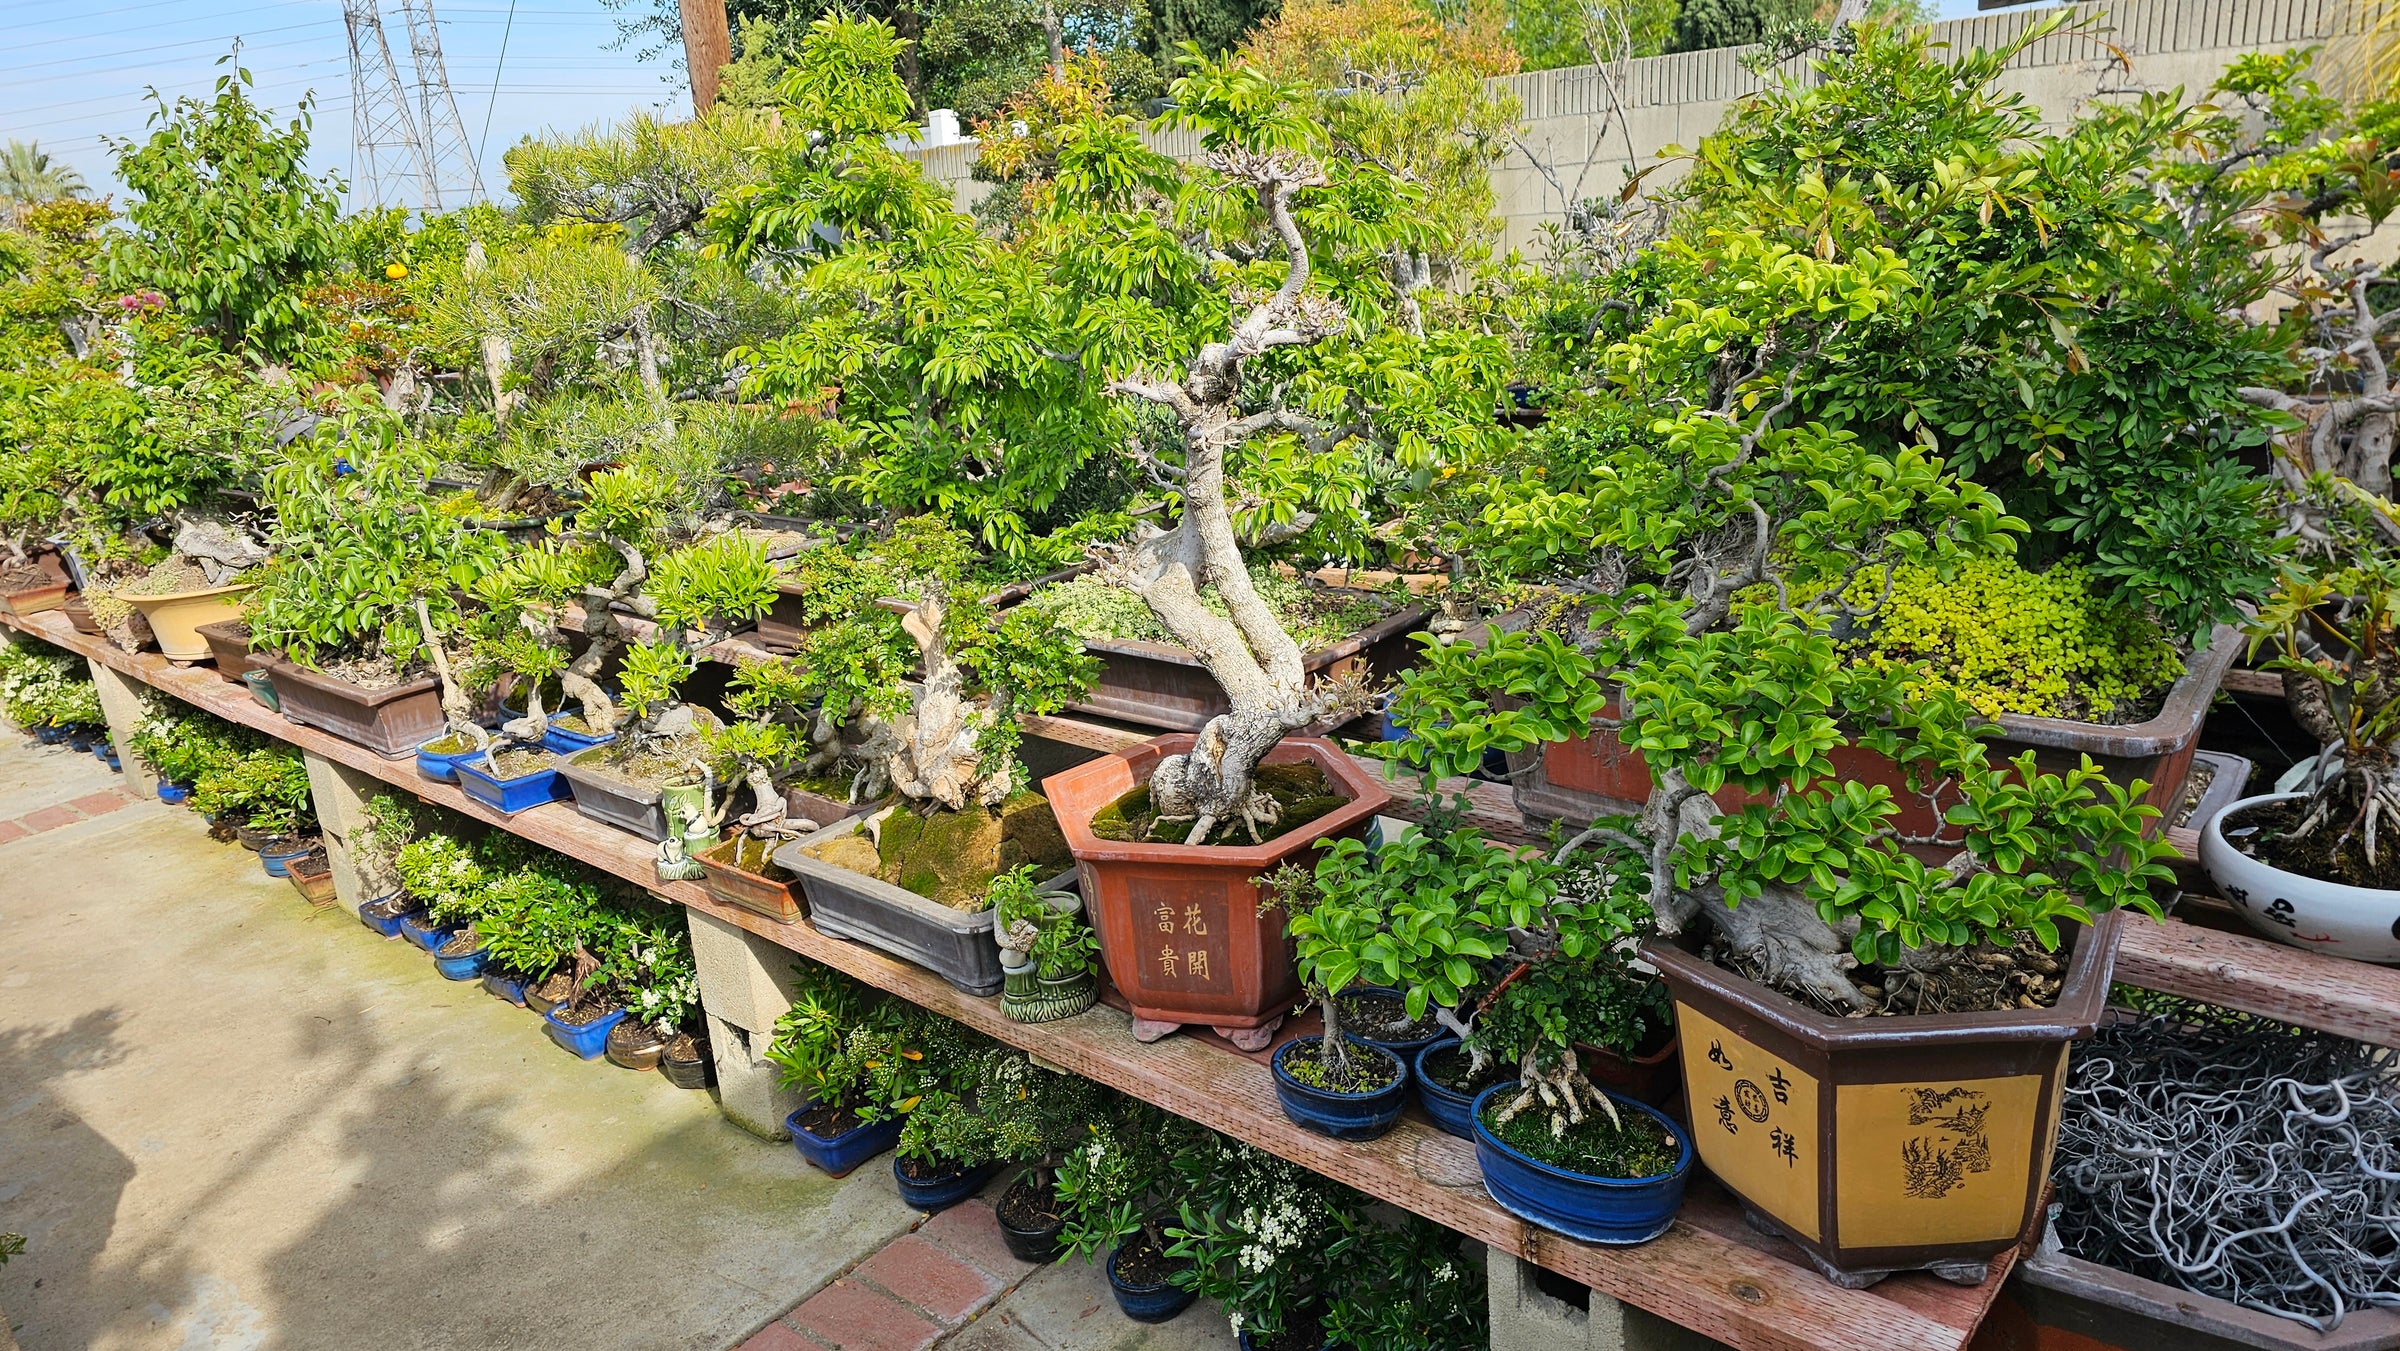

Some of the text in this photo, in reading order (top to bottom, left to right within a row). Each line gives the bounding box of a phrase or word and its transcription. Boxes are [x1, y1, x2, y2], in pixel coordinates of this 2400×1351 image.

[1153, 901, 1180, 979] 富貴
[1183, 902, 1210, 981] 花開
[1707, 1038, 1739, 1136] 如意
[1767, 1066, 1800, 1169] 吉祥
